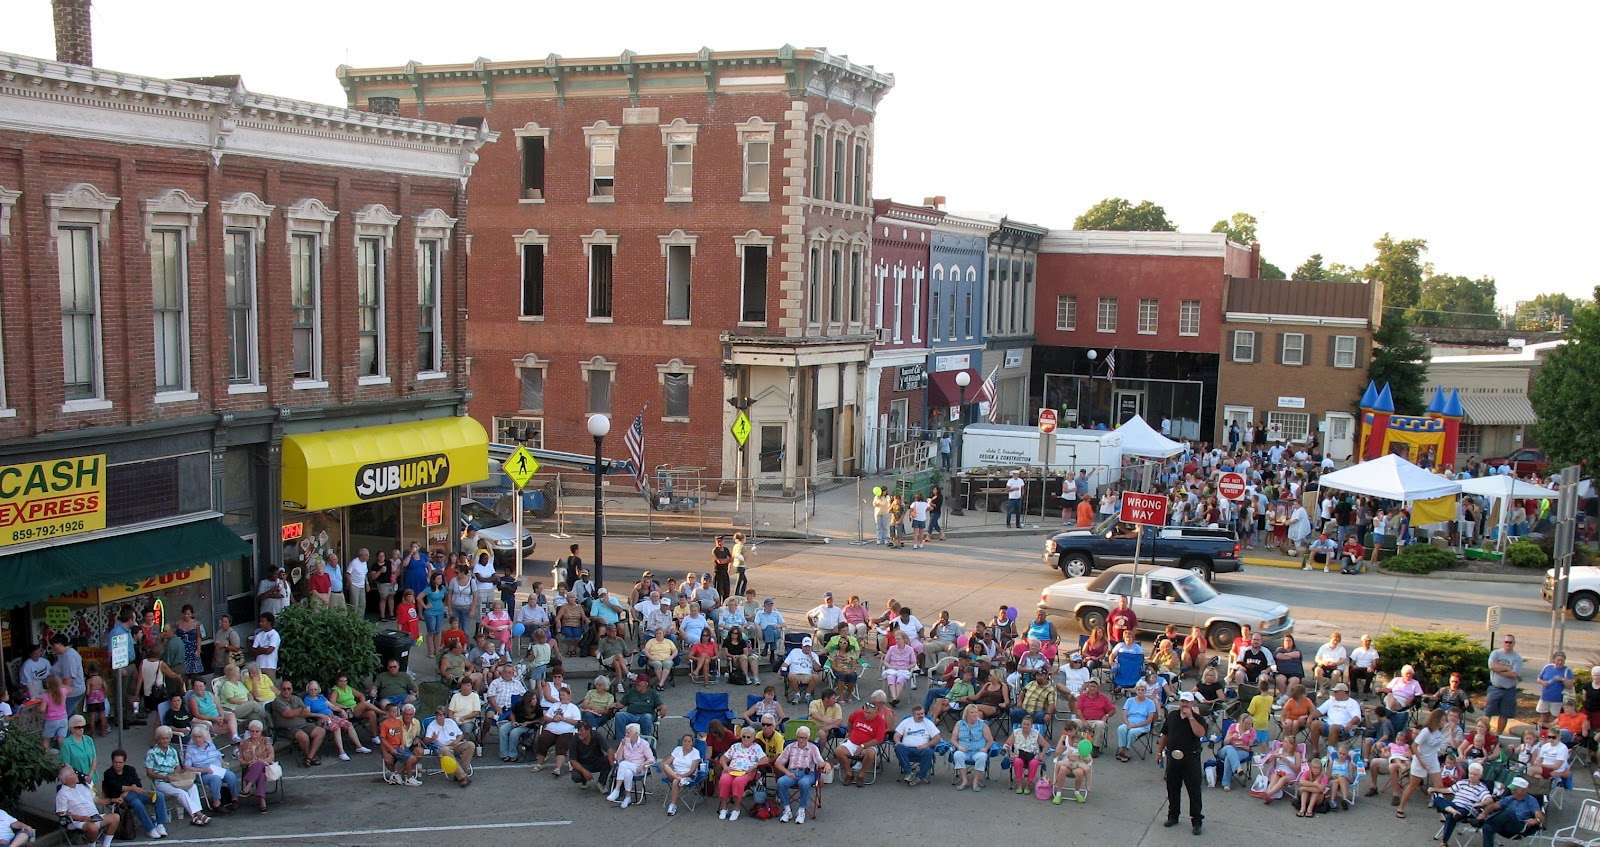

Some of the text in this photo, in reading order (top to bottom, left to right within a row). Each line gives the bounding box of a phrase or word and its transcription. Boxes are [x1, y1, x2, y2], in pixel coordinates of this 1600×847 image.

[0, 457, 99, 499] CASH
[357, 457, 447, 495] SUBWAY
[0, 495, 99, 524] EXPRESS
[1127, 497, 1162, 510] WRONG
[1132, 509, 1154, 521] WAY
[12, 520, 84, 541] 859-792-1926
[282, 524, 303, 540] OPEN
